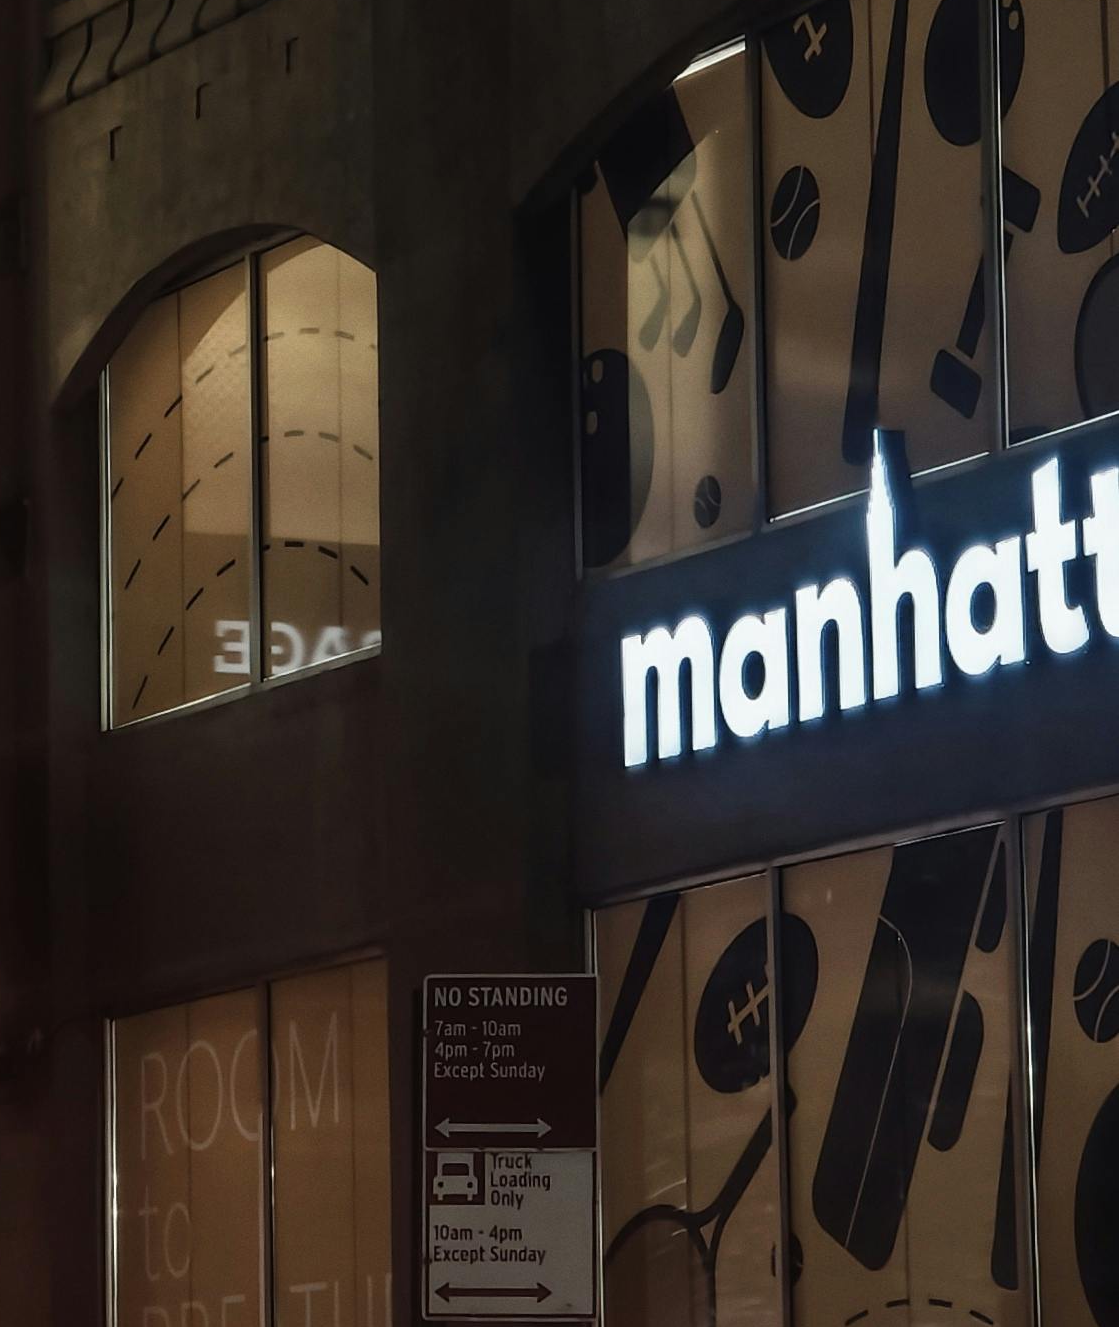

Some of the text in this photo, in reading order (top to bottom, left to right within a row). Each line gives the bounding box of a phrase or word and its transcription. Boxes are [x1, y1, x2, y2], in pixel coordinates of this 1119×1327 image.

[434, 986, 568, 1007] NO STANDING
[434, 1020, 466, 1036] 7am
[482, 1020, 521, 1036] 10am
[434, 1041, 467, 1061] 4pm
[482, 1041, 515, 1060] 7pm
[434, 1062, 545, 1081] Except Sunday
[140, 1011, 340, 1159] ROOM
[491, 1153, 532, 1169] Truck
[490, 1172, 551, 1191] Loading
[490, 1190, 524, 1210] Only
[138, 1184, 192, 1281] to
[434, 1225, 473, 1240] 10am
[489, 1225, 522, 1244] 4pm
[433, 1246, 546, 1265] Except Sunday
